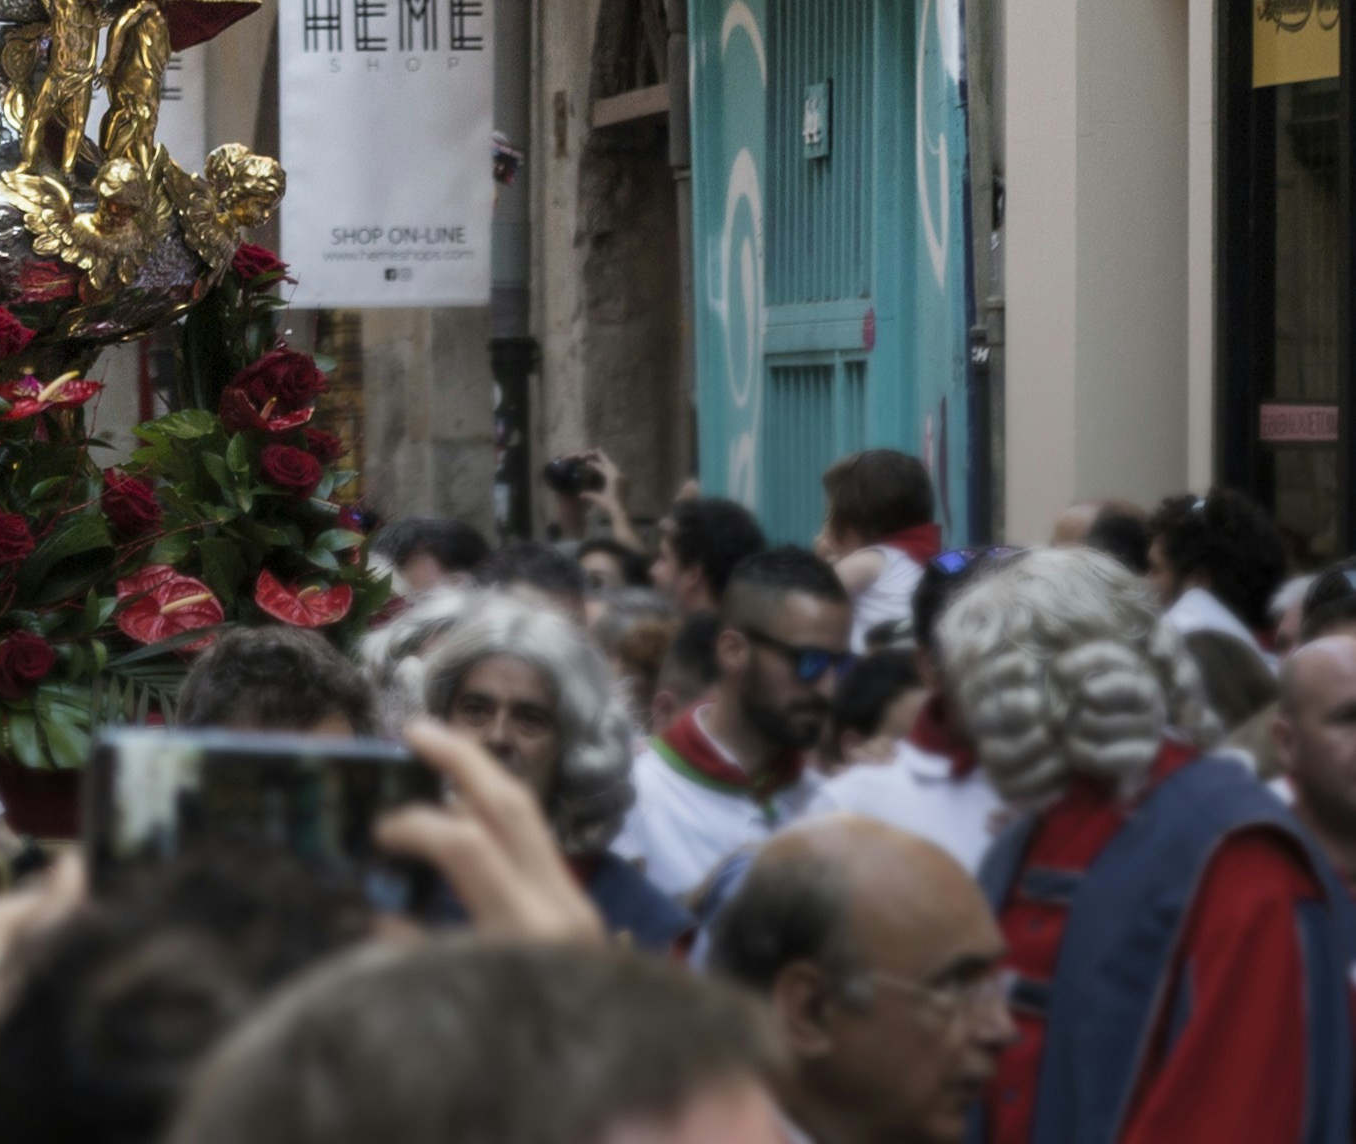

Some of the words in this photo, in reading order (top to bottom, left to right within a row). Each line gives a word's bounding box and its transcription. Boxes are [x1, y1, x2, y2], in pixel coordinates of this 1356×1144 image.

[329, 56, 459, 73] SHOP
[331, 227, 383, 246] SHOP
[388, 226, 466, 246] ON-LINE
